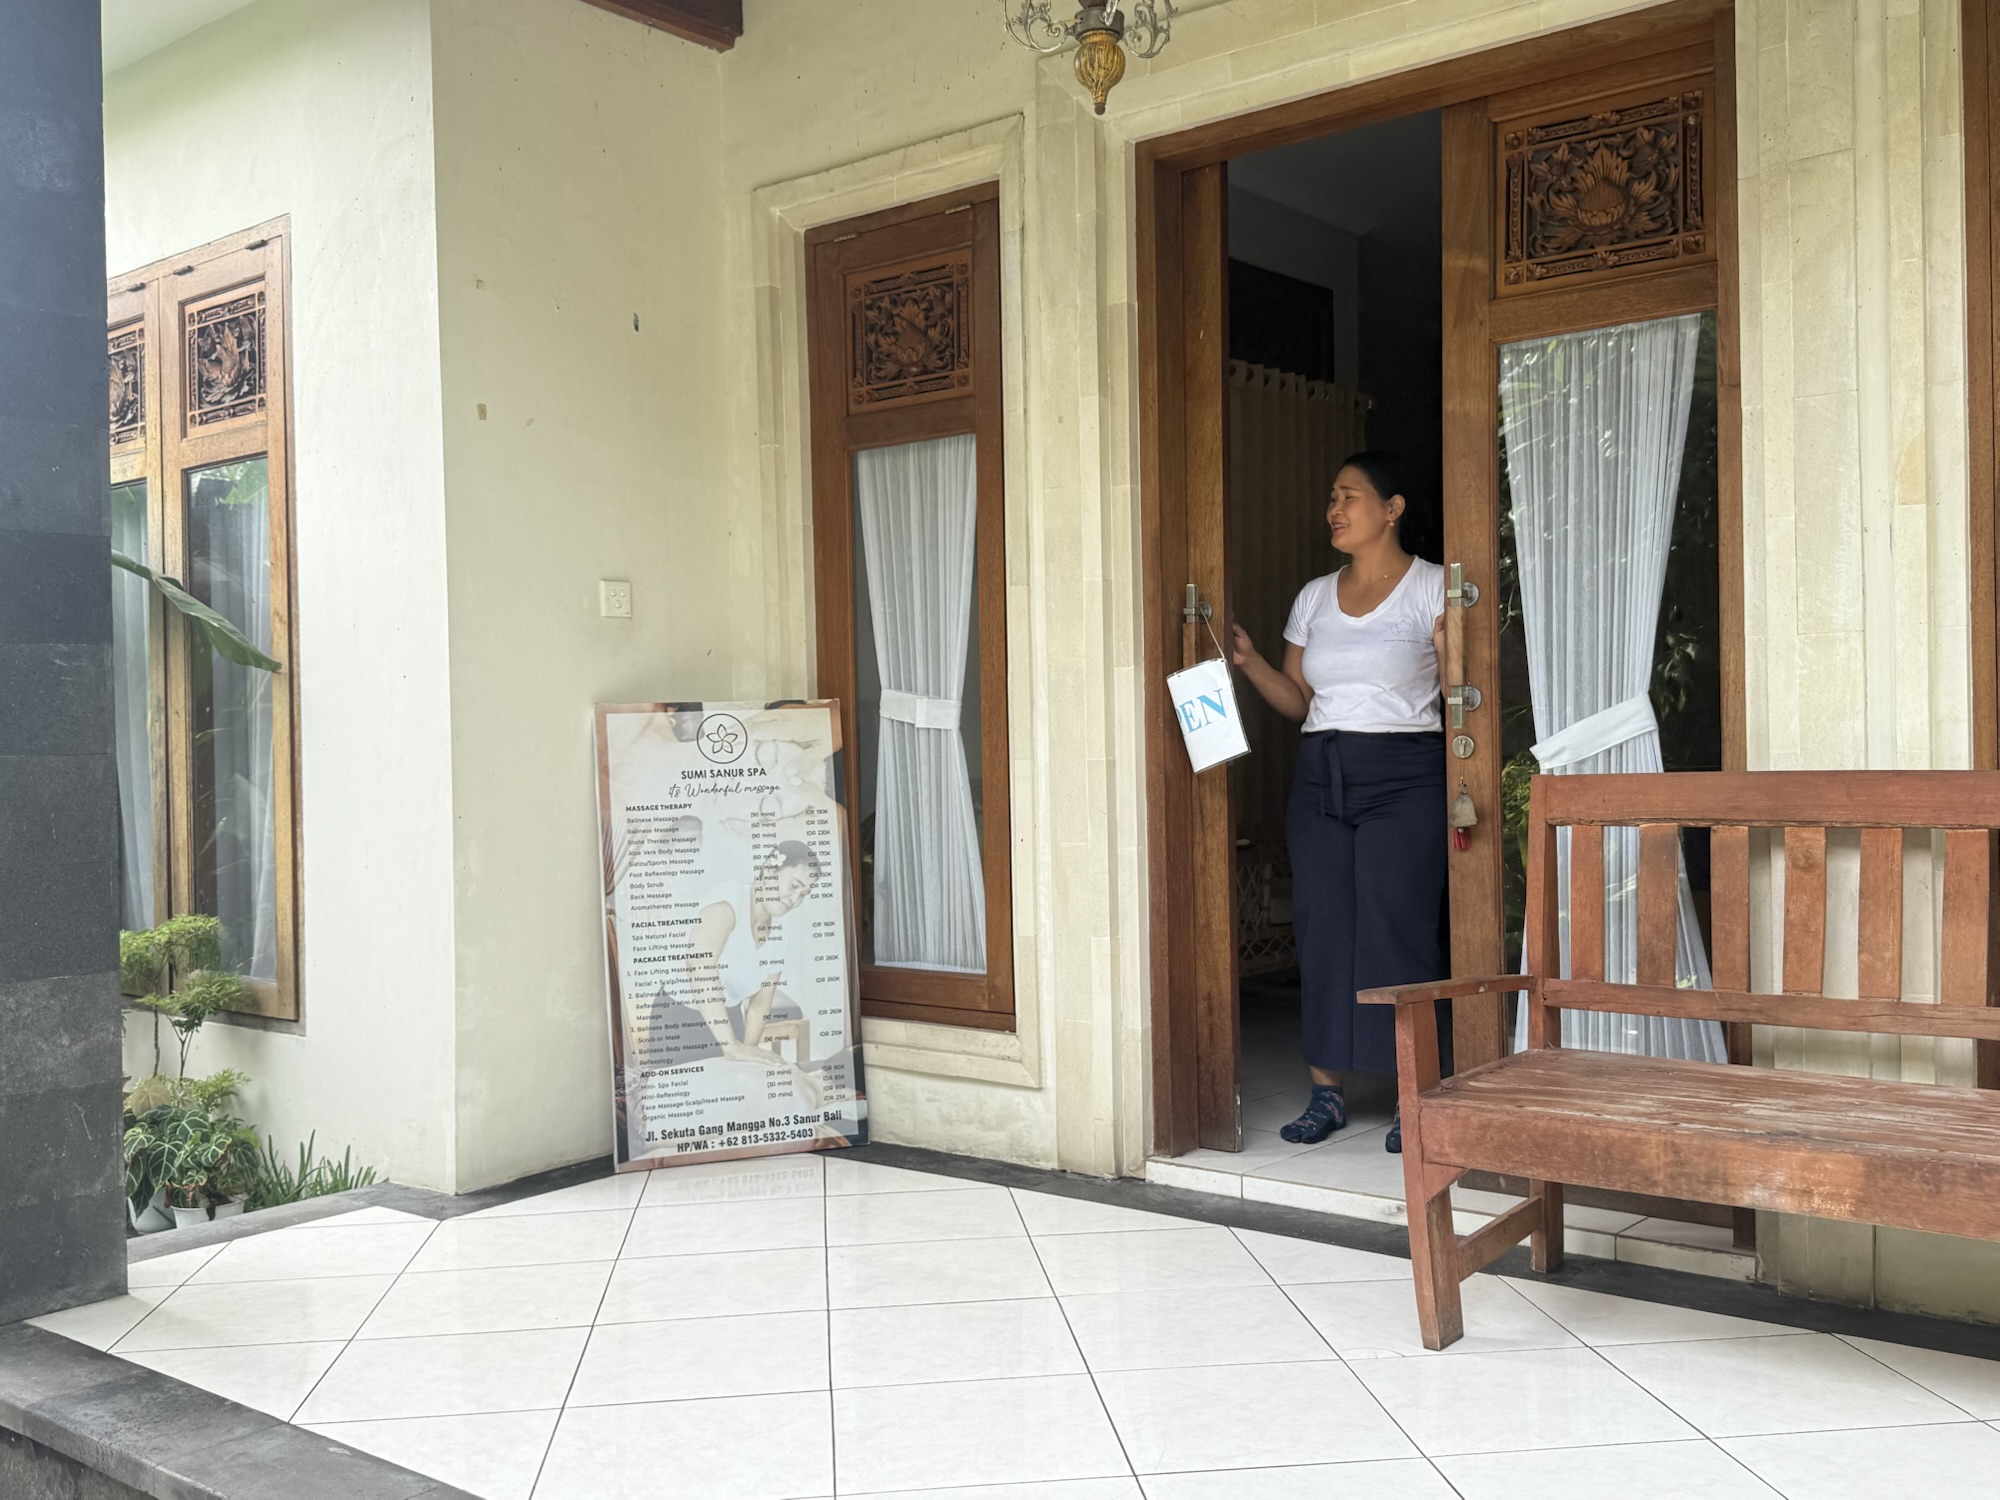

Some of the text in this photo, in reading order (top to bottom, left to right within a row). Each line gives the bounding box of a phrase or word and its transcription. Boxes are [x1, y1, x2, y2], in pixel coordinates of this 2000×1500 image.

[681, 767, 767, 779] SUMI SANUR SPA
[685, 782, 742, 797] Wonderful
[744, 785, 781, 794] massage
[658, 918, 702, 926] TREATMENTS
[633, 952, 713, 964] PACKAGE TREATMENTS
[641, 1066, 704, 1078] ADD-ON SERVICES
[645, 1110, 842, 1141] Jl. Sekuta Gang Mangga No.3 Sanur Bali
[677, 1140, 709, 1152] HP/WA
[718, 1137, 739, 1147] +62
[742, 1128, 813, 1145] 813-5332-5403
